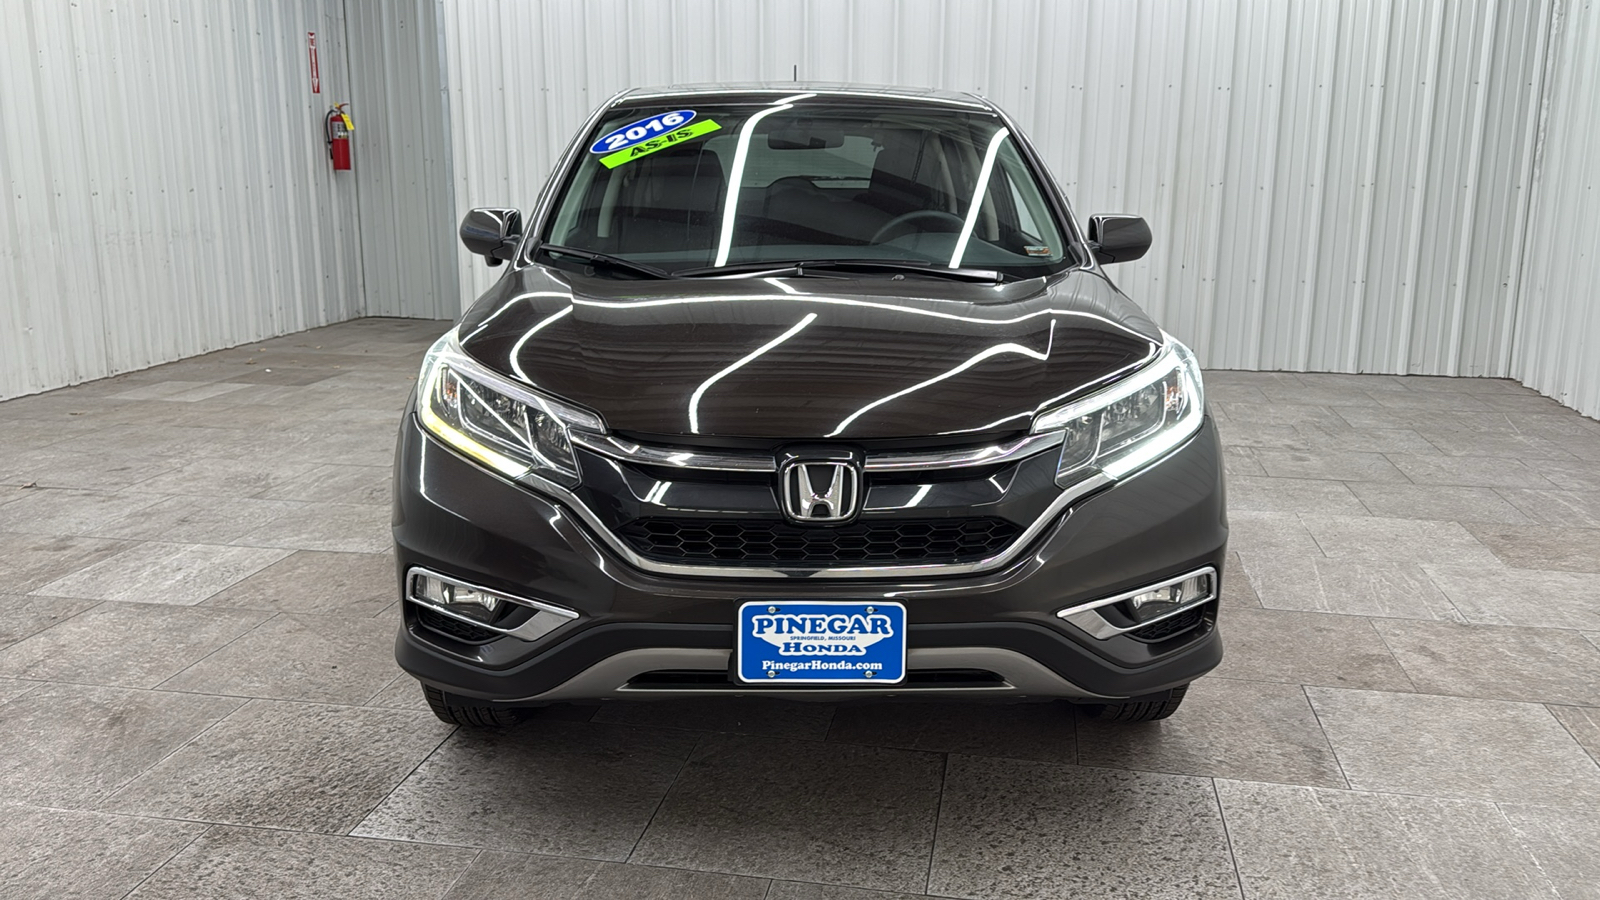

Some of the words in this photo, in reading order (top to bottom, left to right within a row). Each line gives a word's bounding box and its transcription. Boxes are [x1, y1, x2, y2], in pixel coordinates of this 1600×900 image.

[604, 112, 685, 150] 2016
[629, 128, 695, 158] AS-IS
[755, 617, 891, 635] PINEGAR
[762, 660, 883, 672] PinegarHonda.com
